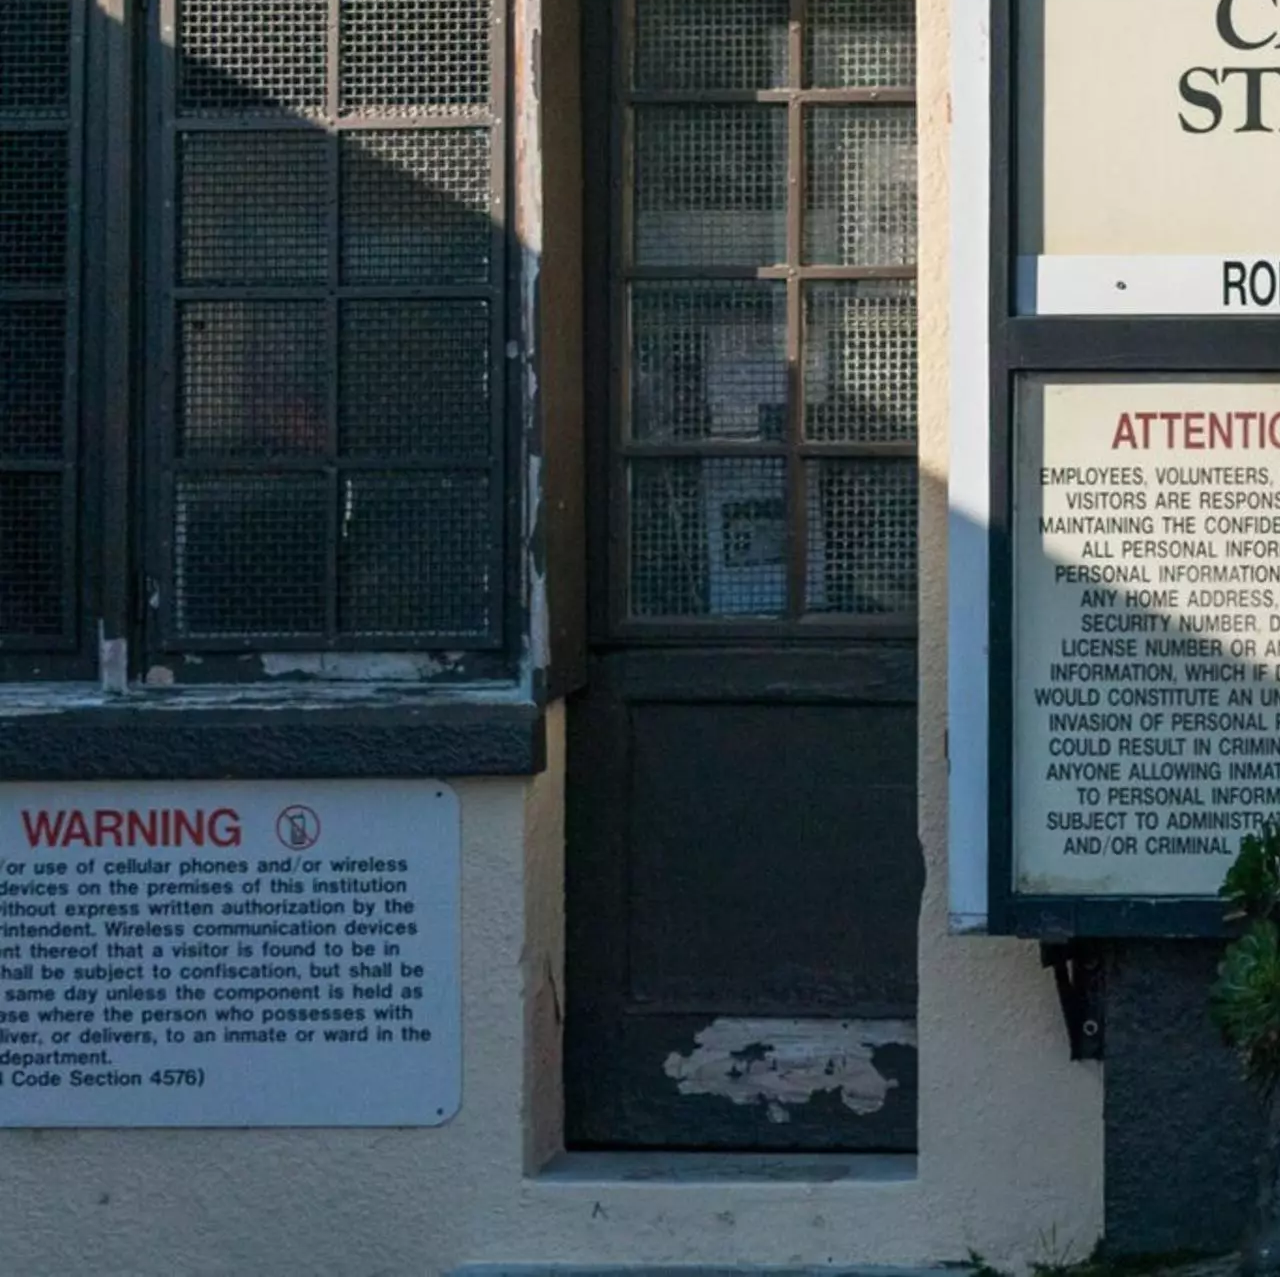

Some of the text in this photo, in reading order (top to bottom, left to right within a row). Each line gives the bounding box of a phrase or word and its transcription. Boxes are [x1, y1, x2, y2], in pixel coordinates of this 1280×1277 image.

[1039, 466, 1148, 486] EMPLOYEES,
[1155, 466, 1273, 486] VOLUNTEERS,
[1065, 491, 1147, 511] VISITORS
[1154, 491, 1192, 510] ARE
[1039, 515, 1154, 535] MAINTAINING
[1161, 515, 1197, 535] THE
[1081, 540, 1115, 559] ALL
[1121, 539, 1218, 559] PERSONAL
[1055, 564, 1152, 584] PERSONAL
[1159, 564, 1280, 584] INFORMATION
[1080, 589, 1118, 608] ANY
[1125, 588, 1179, 609] HOME
[1186, 588, 1279, 609] ADDRESS,
[1081, 613, 1172, 633] SECURITY
[1179, 613, 1263, 637] NUMBER,
[1061, 638, 1137, 658] LICENSE
[1145, 638, 1223, 658] NUMBER
[1230, 638, 1257, 658] OR
[1050, 662, 1177, 683] INFORMATION,
[1185, 663, 1246, 682] WHICH
[1253, 663, 1268, 682] IF
[1034, 687, 1101, 708] WOULD
[1107, 687, 1220, 707] CONSTITUTE
[1227, 688, 1253, 706] AN
[1045, 762, 1121, 782] ANYONE
[1127, 761, 1222, 782] ALLOWING
[21, 808, 242, 848] WARNING
[1063, 835, 1233, 856] AND/OR CRIMINAL
[33, 856, 408, 878] use of cellular phones and/or wireless
[76, 882, 101, 896] on
[108, 878, 140, 896] the
[146, 878, 234, 899] premises
[241, 877, 261, 895] of
[270, 877, 305, 895] this
[312, 876, 407, 894] institution
[64, 898, 415, 920] express written authorization by the
[104, 919, 418, 938] Wireless communication devices
[40, 961, 425, 983] be subject to confiscation, but shall be
[50, 1025, 432, 1046] or delivers, to an inmate or ward in the
[0, 1049, 113, 1069] department.
[11, 1067, 205, 1088] Code Section 4576)
